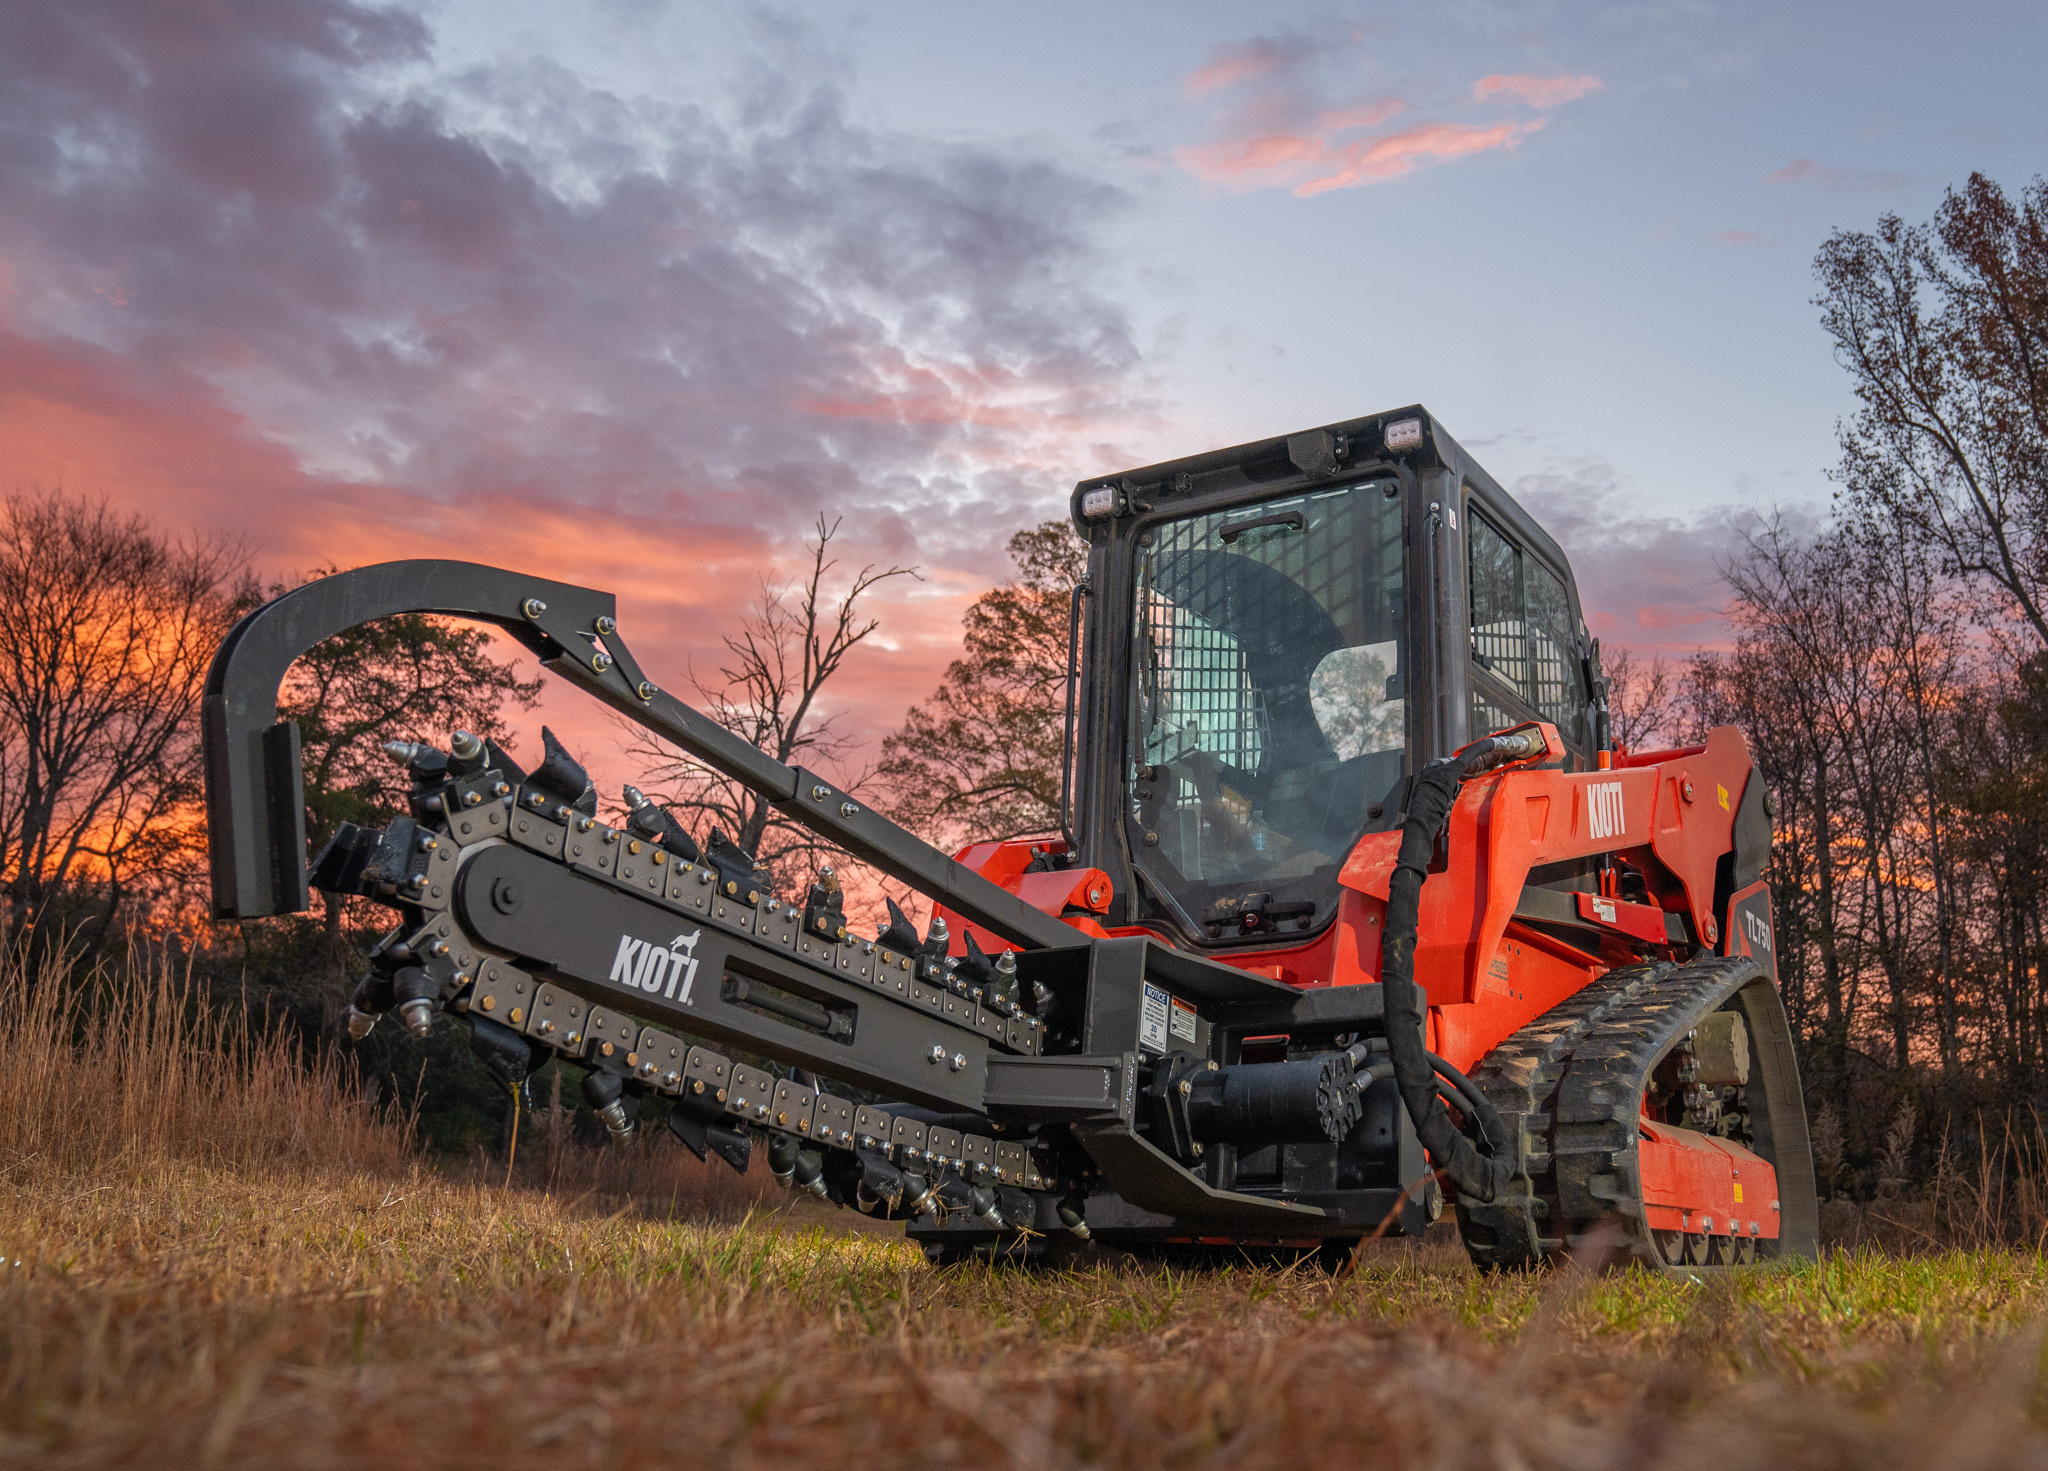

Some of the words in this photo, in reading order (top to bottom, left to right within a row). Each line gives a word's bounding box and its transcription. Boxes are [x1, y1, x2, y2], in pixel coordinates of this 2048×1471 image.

[1587, 782, 1625, 839] KIOTI
[1746, 910, 1770, 952] TL750
[609, 935, 699, 1003] KIOTI
[1146, 986, 1166, 1004] NOTICE
[1151, 1024, 1157, 1033] 20
